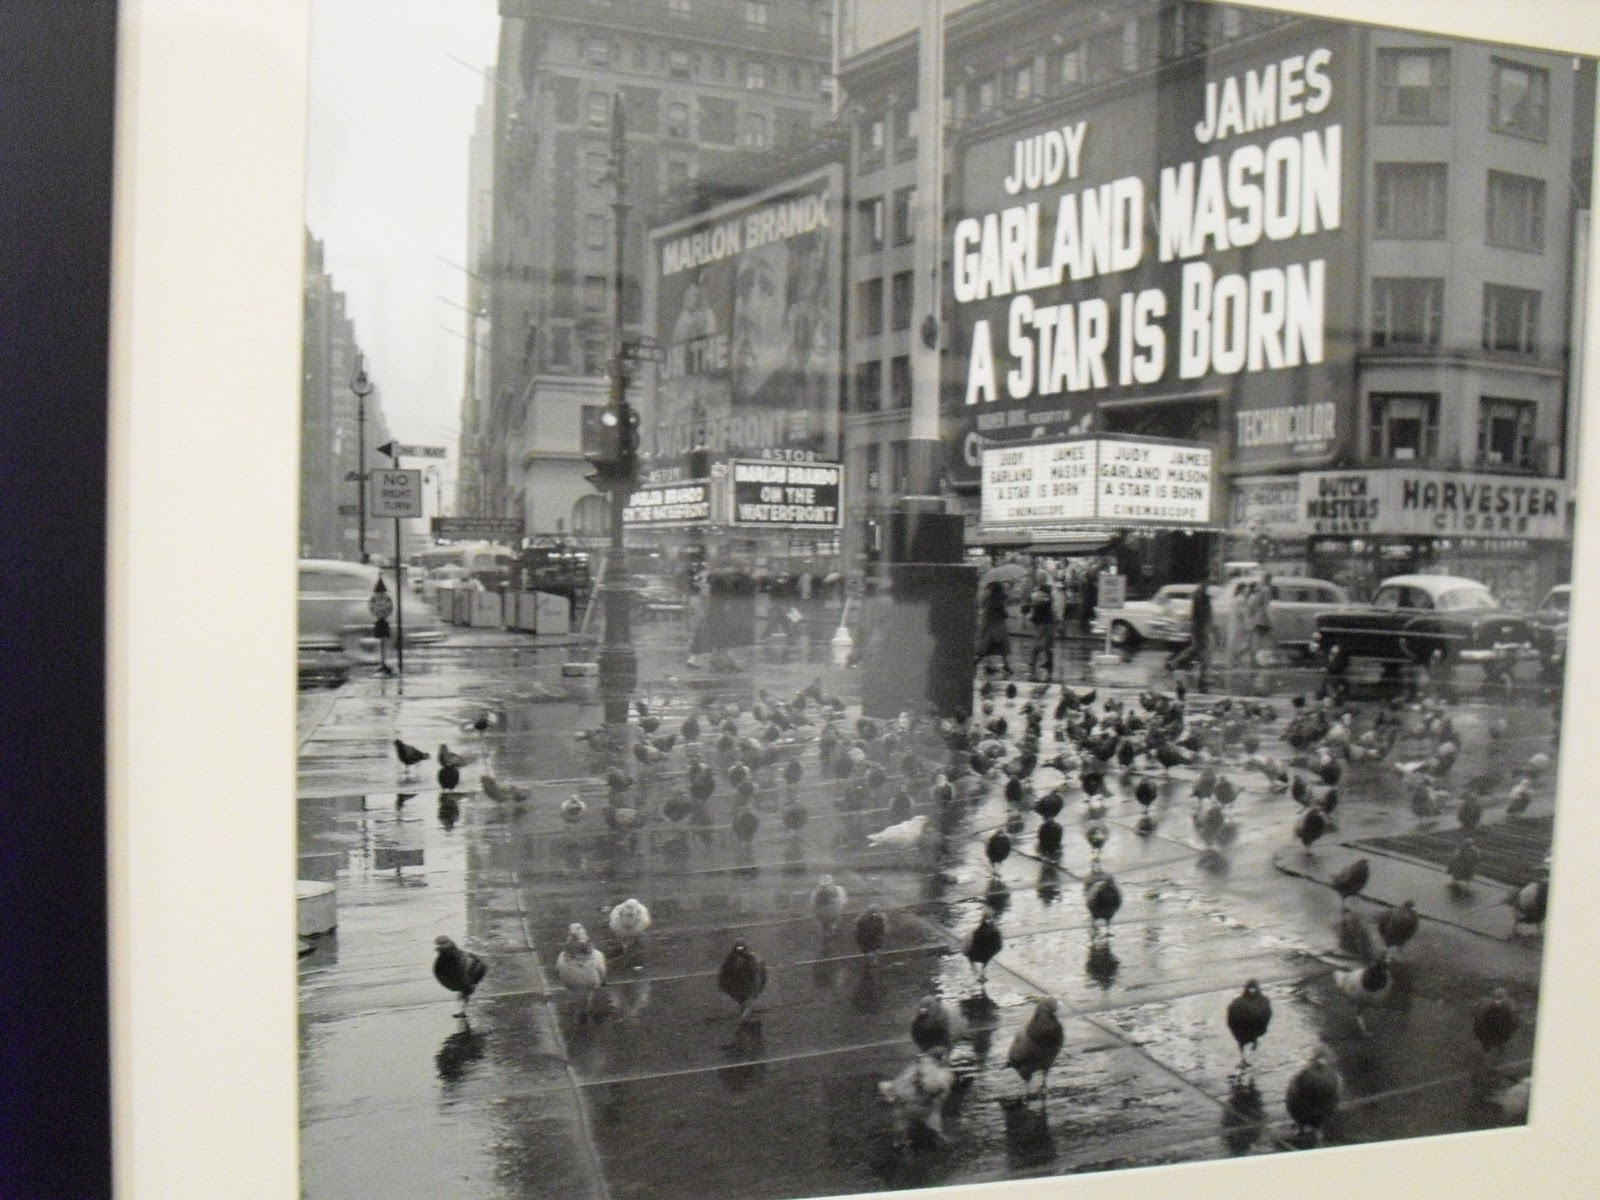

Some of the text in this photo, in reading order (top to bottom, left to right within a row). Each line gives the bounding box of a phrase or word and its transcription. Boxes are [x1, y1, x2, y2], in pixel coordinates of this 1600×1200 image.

[1195, 48, 1332, 143] JAMES
[1005, 122, 1087, 195] JUDY
[953, 125, 1341, 303] GARLAND MASON
[663, 218, 742, 276] MARLON
[965, 260, 1325, 405] A STAR IS BORN
[762, 448, 815, 462] ASTOR
[1000, 446, 1085, 467] JUDY JAMES
[1114, 449, 1209, 467] JUDY JAMES
[383, 474, 409, 486] NO
[990, 463, 1087, 484] GARLAND MASON
[1101, 464, 1209, 483] GARLAND MASON
[760, 486, 816, 504] ON THE
[1006, 485, 1030, 499] STAR
[1037, 484, 1047, 498] IS
[1053, 482, 1078, 496] BORN
[1104, 483, 1203, 499] A STAR IS BORN
[1403, 479, 1558, 516] HARVESTER
[739, 503, 836, 522] WATERFRONT
[1114, 504, 1197, 518] CINEMASCOPE
